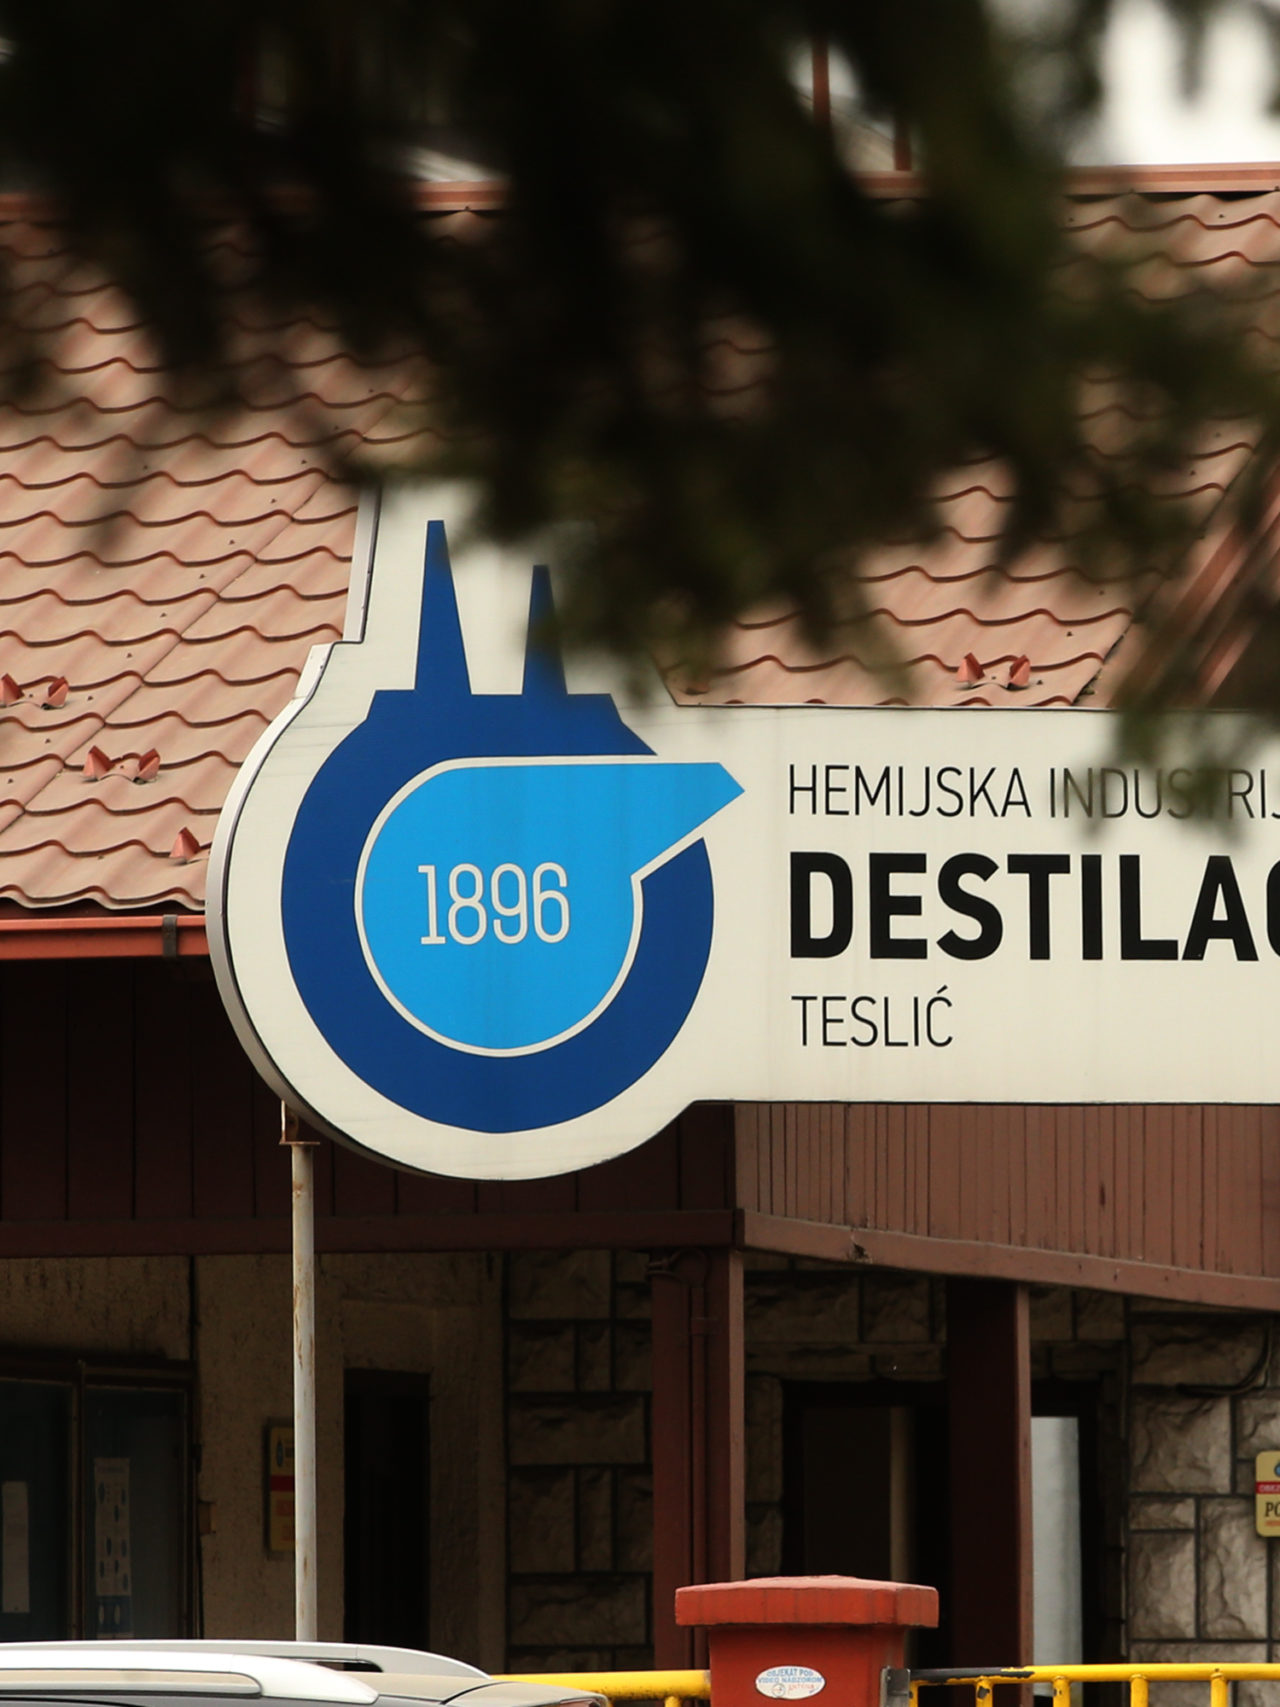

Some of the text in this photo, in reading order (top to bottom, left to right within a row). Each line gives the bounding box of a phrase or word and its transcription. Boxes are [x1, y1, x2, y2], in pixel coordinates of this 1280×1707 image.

[788, 763, 1032, 818] HEMIJSKA
[417, 861, 570, 945] 1896
[791, 985, 953, 1047] TESLIĆ
[799, 1668, 814, 1677] POD
